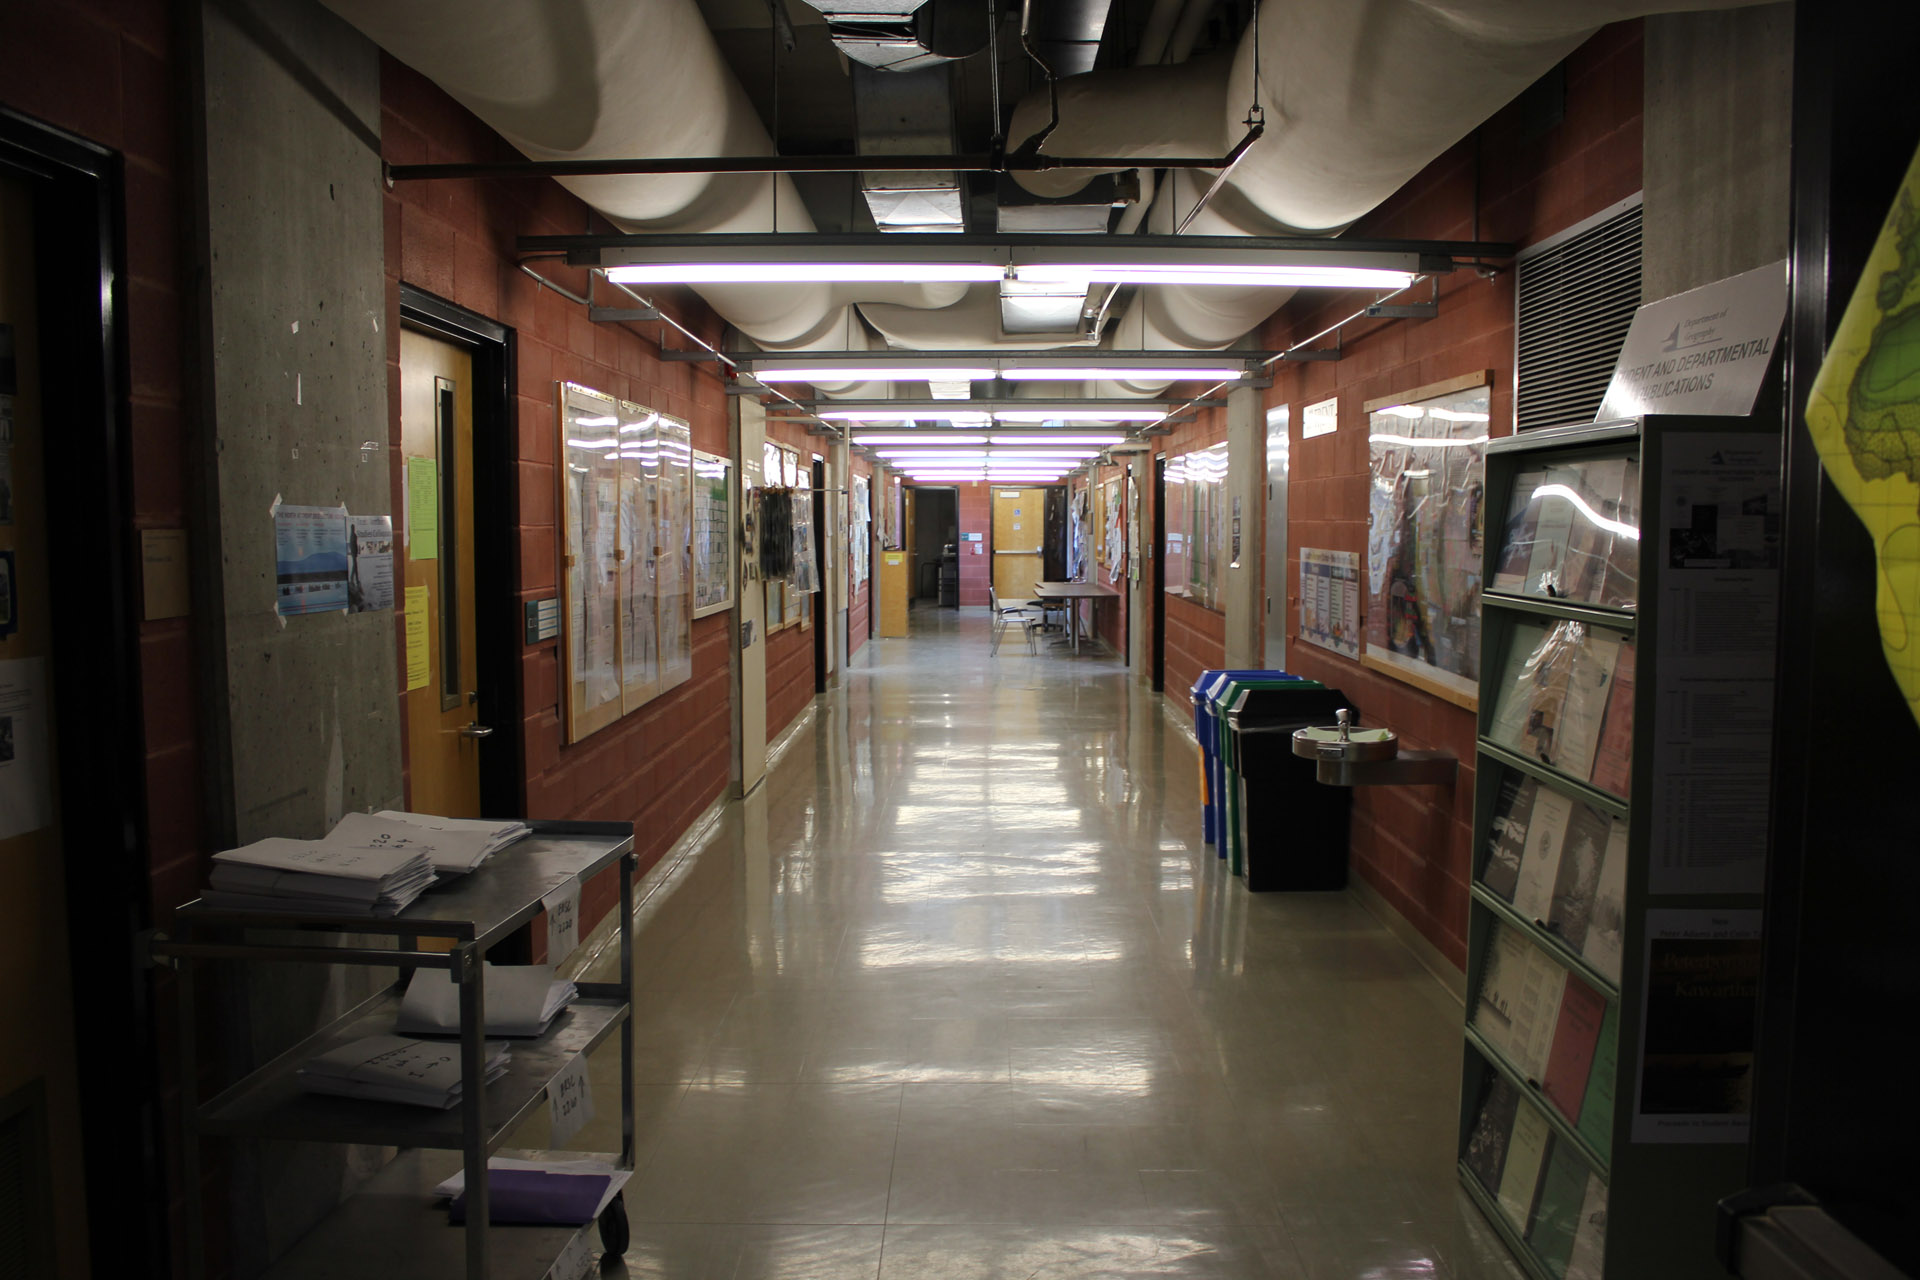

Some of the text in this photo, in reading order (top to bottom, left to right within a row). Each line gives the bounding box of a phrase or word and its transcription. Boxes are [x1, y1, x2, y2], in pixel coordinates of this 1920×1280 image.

[1652, 358, 1676, 377] AND
[1676, 337, 1770, 373] DEPARTMENTAL
[1636, 373, 1715, 401] UBLICATIONS
